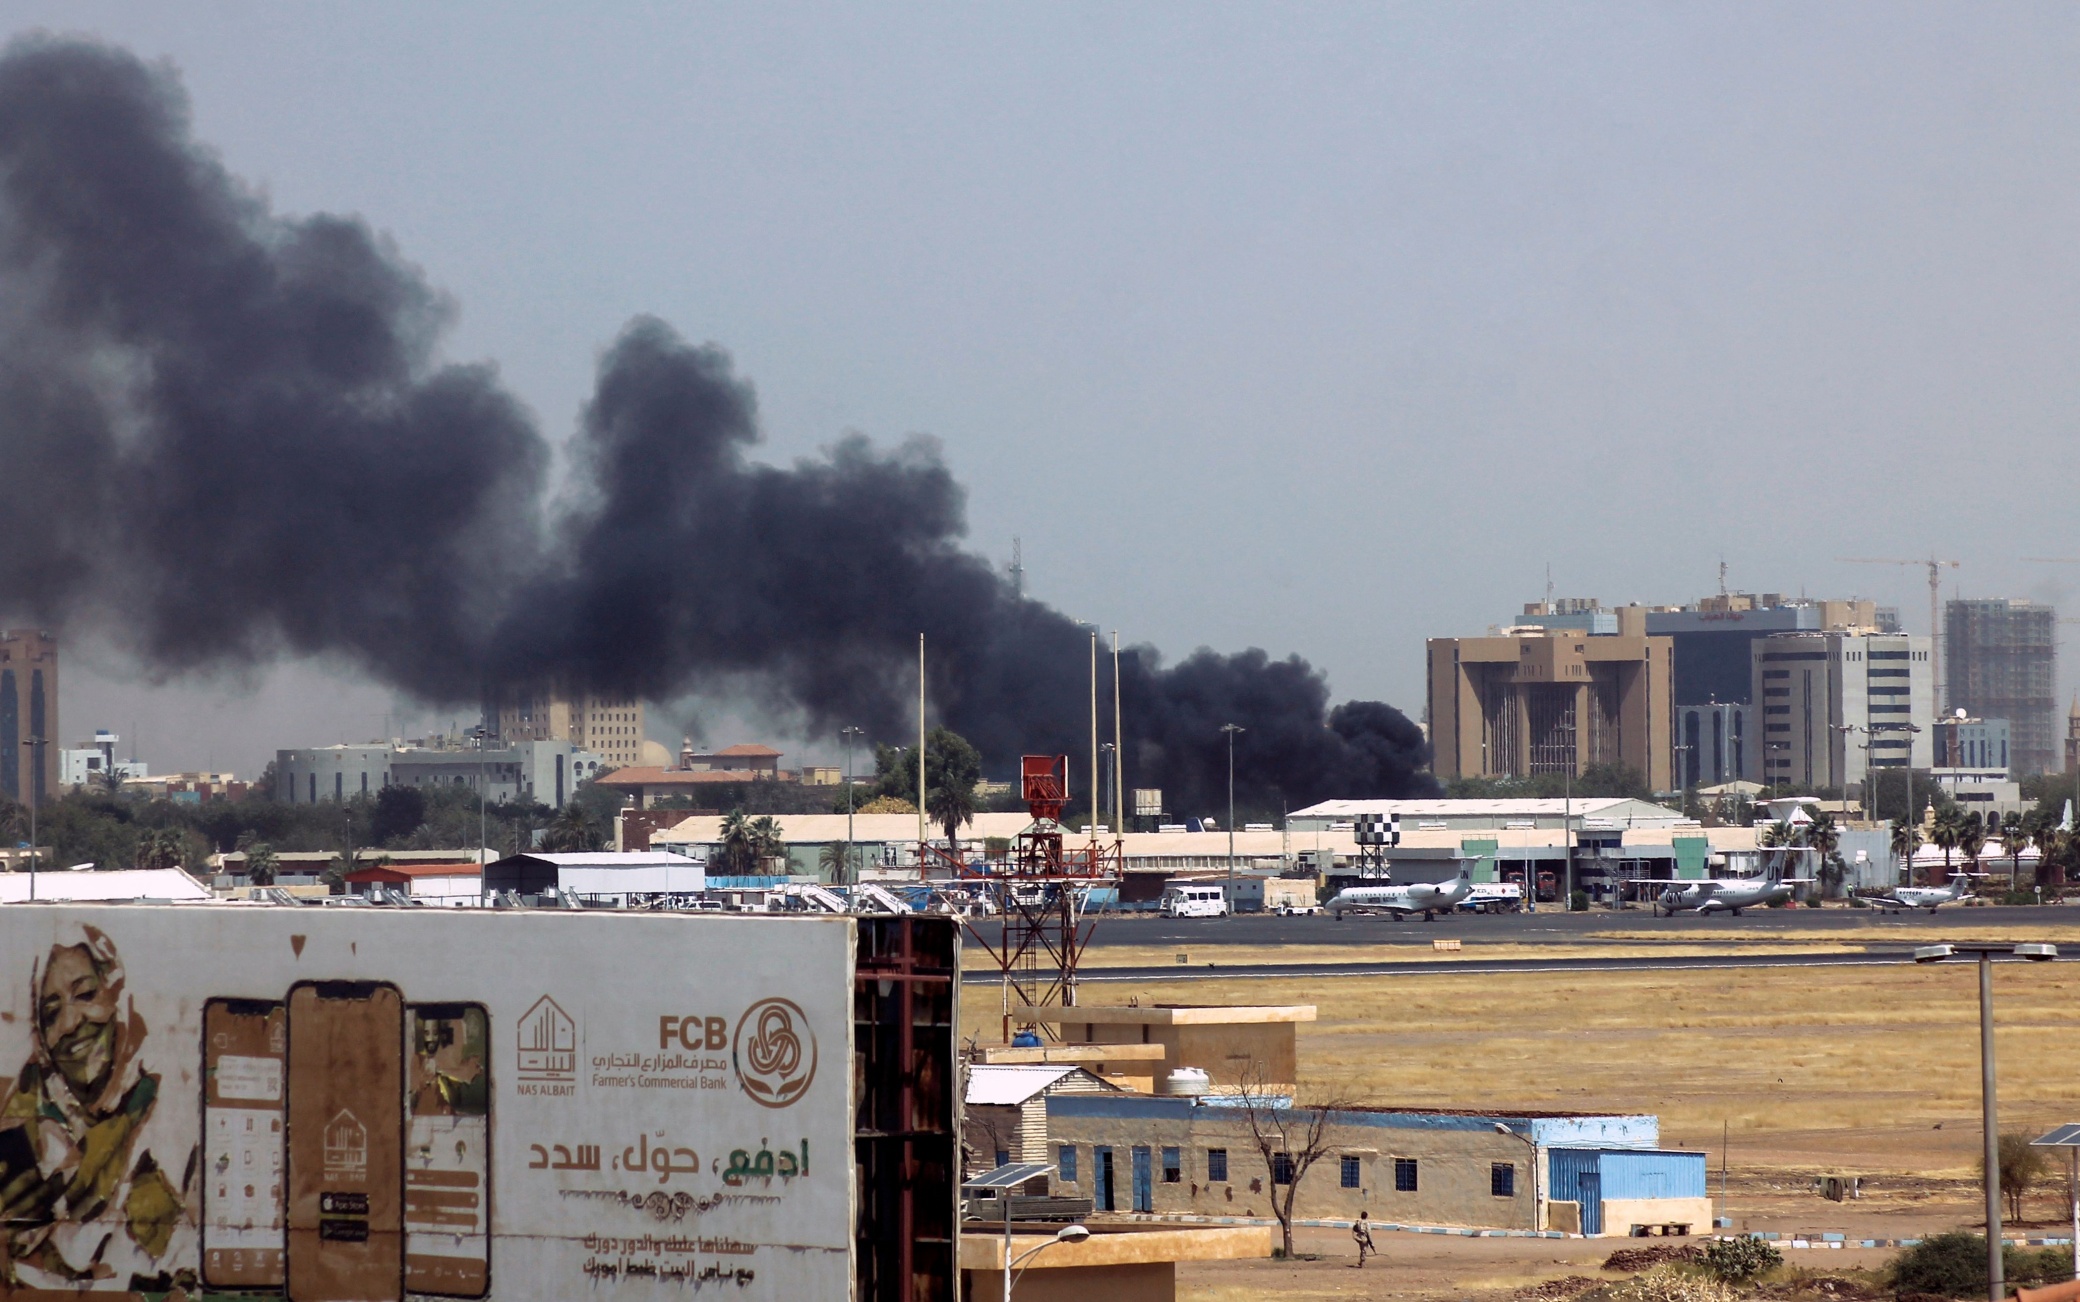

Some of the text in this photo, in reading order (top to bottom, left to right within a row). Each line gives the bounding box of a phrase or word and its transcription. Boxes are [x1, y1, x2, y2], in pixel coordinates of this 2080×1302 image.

[1459, 870, 1469, 880] UN
[659, 1015, 728, 1050] FCB
[592, 1052, 727, 1073] مصرف المزارع التجاري
[517, 1084, 576, 1097] NAS ALBAIT
[592, 1074, 727, 1090] Farmer's Commercial Bank
[528, 1143, 601, 1171] سدد
